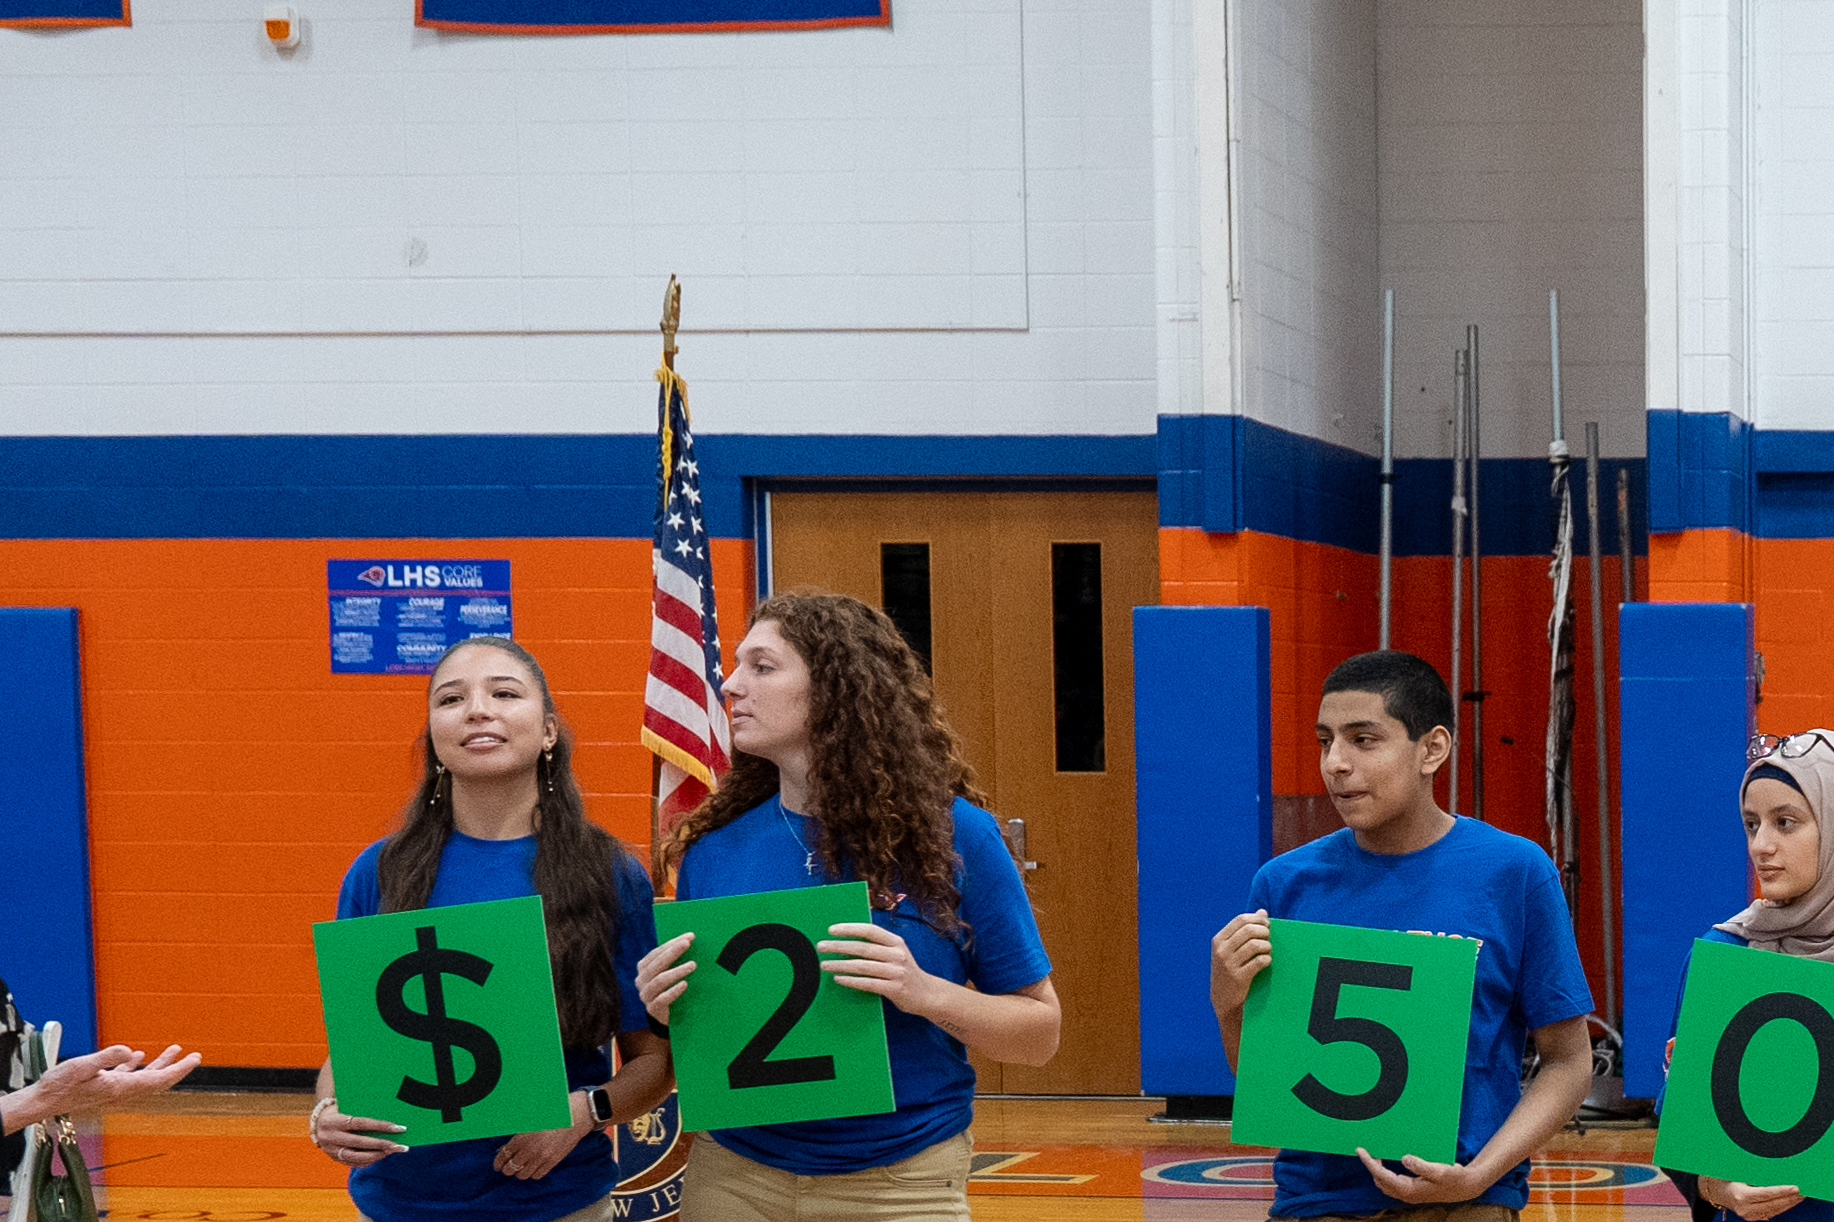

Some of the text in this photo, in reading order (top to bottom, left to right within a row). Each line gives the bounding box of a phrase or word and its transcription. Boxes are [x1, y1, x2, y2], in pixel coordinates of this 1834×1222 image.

[387, 565, 482, 587] LHS CORE
[444, 577, 483, 587] VALUES
[375, 926, 502, 1124] $
[715, 922, 836, 1090] 2
[1291, 957, 1412, 1121] 5
